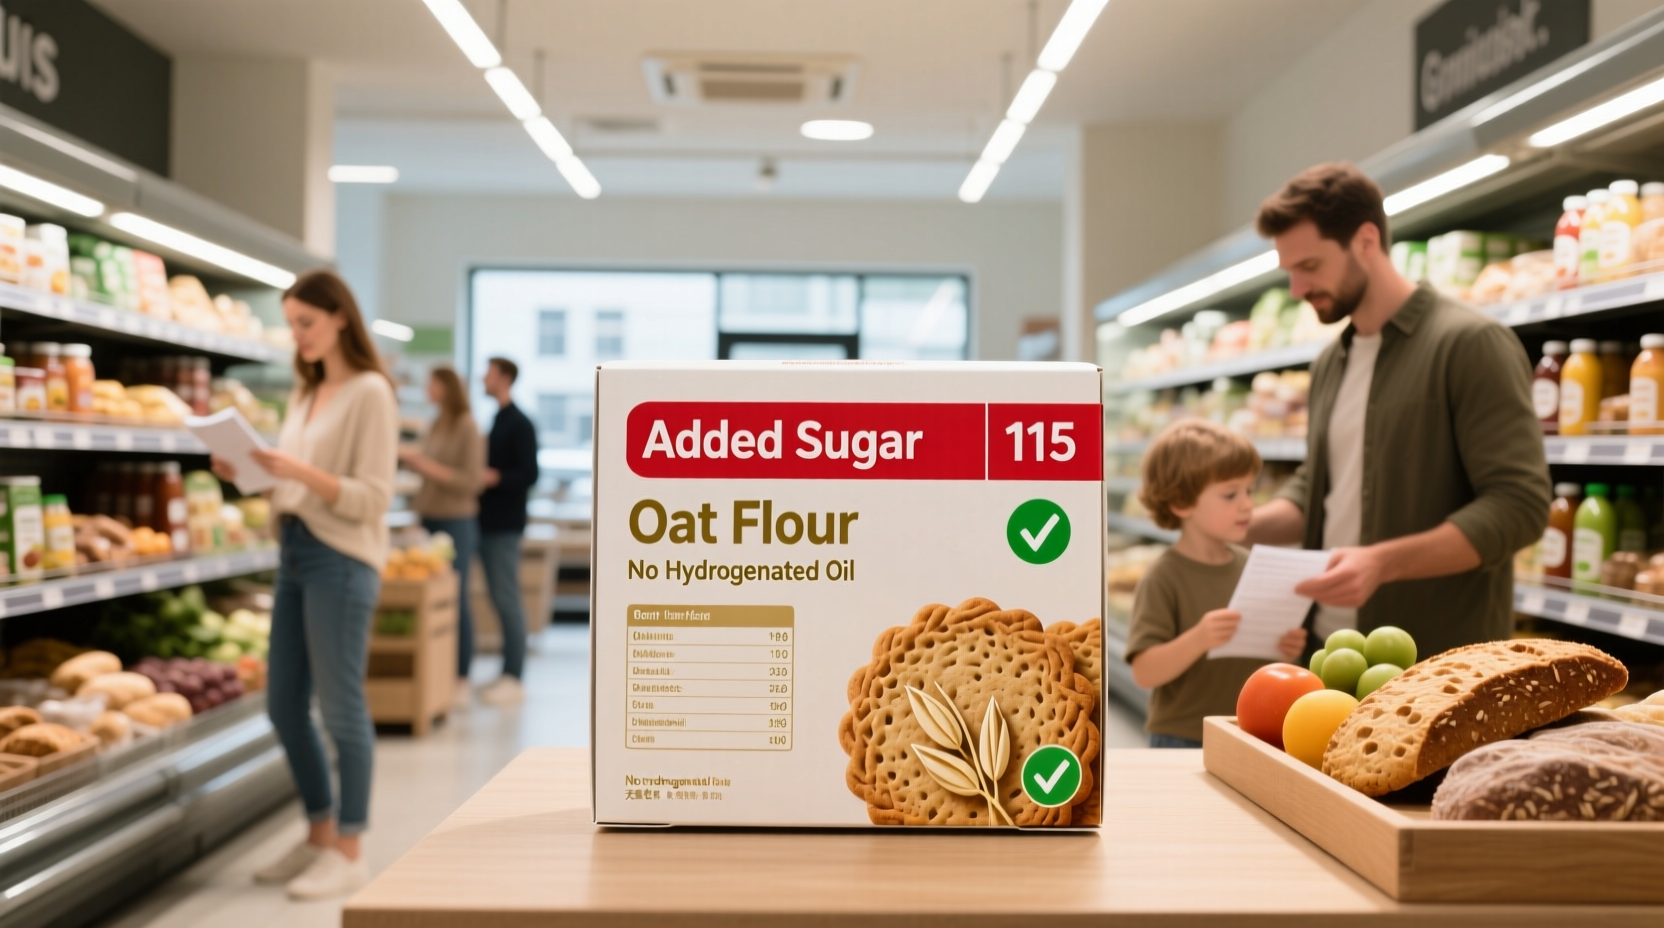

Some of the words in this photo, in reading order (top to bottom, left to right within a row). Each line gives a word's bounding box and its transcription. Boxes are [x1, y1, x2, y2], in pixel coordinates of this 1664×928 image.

[642, 419, 783, 460] Added
[795, 420, 924, 470] Sugar
[1005, 421, 1076, 462] 115
[628, 498, 718, 545] Oat
[732, 499, 860, 545] Flour
[628, 560, 659, 581] No
[665, 560, 819, 586] Hydrogenated
[825, 559, 855, 582] Oil
